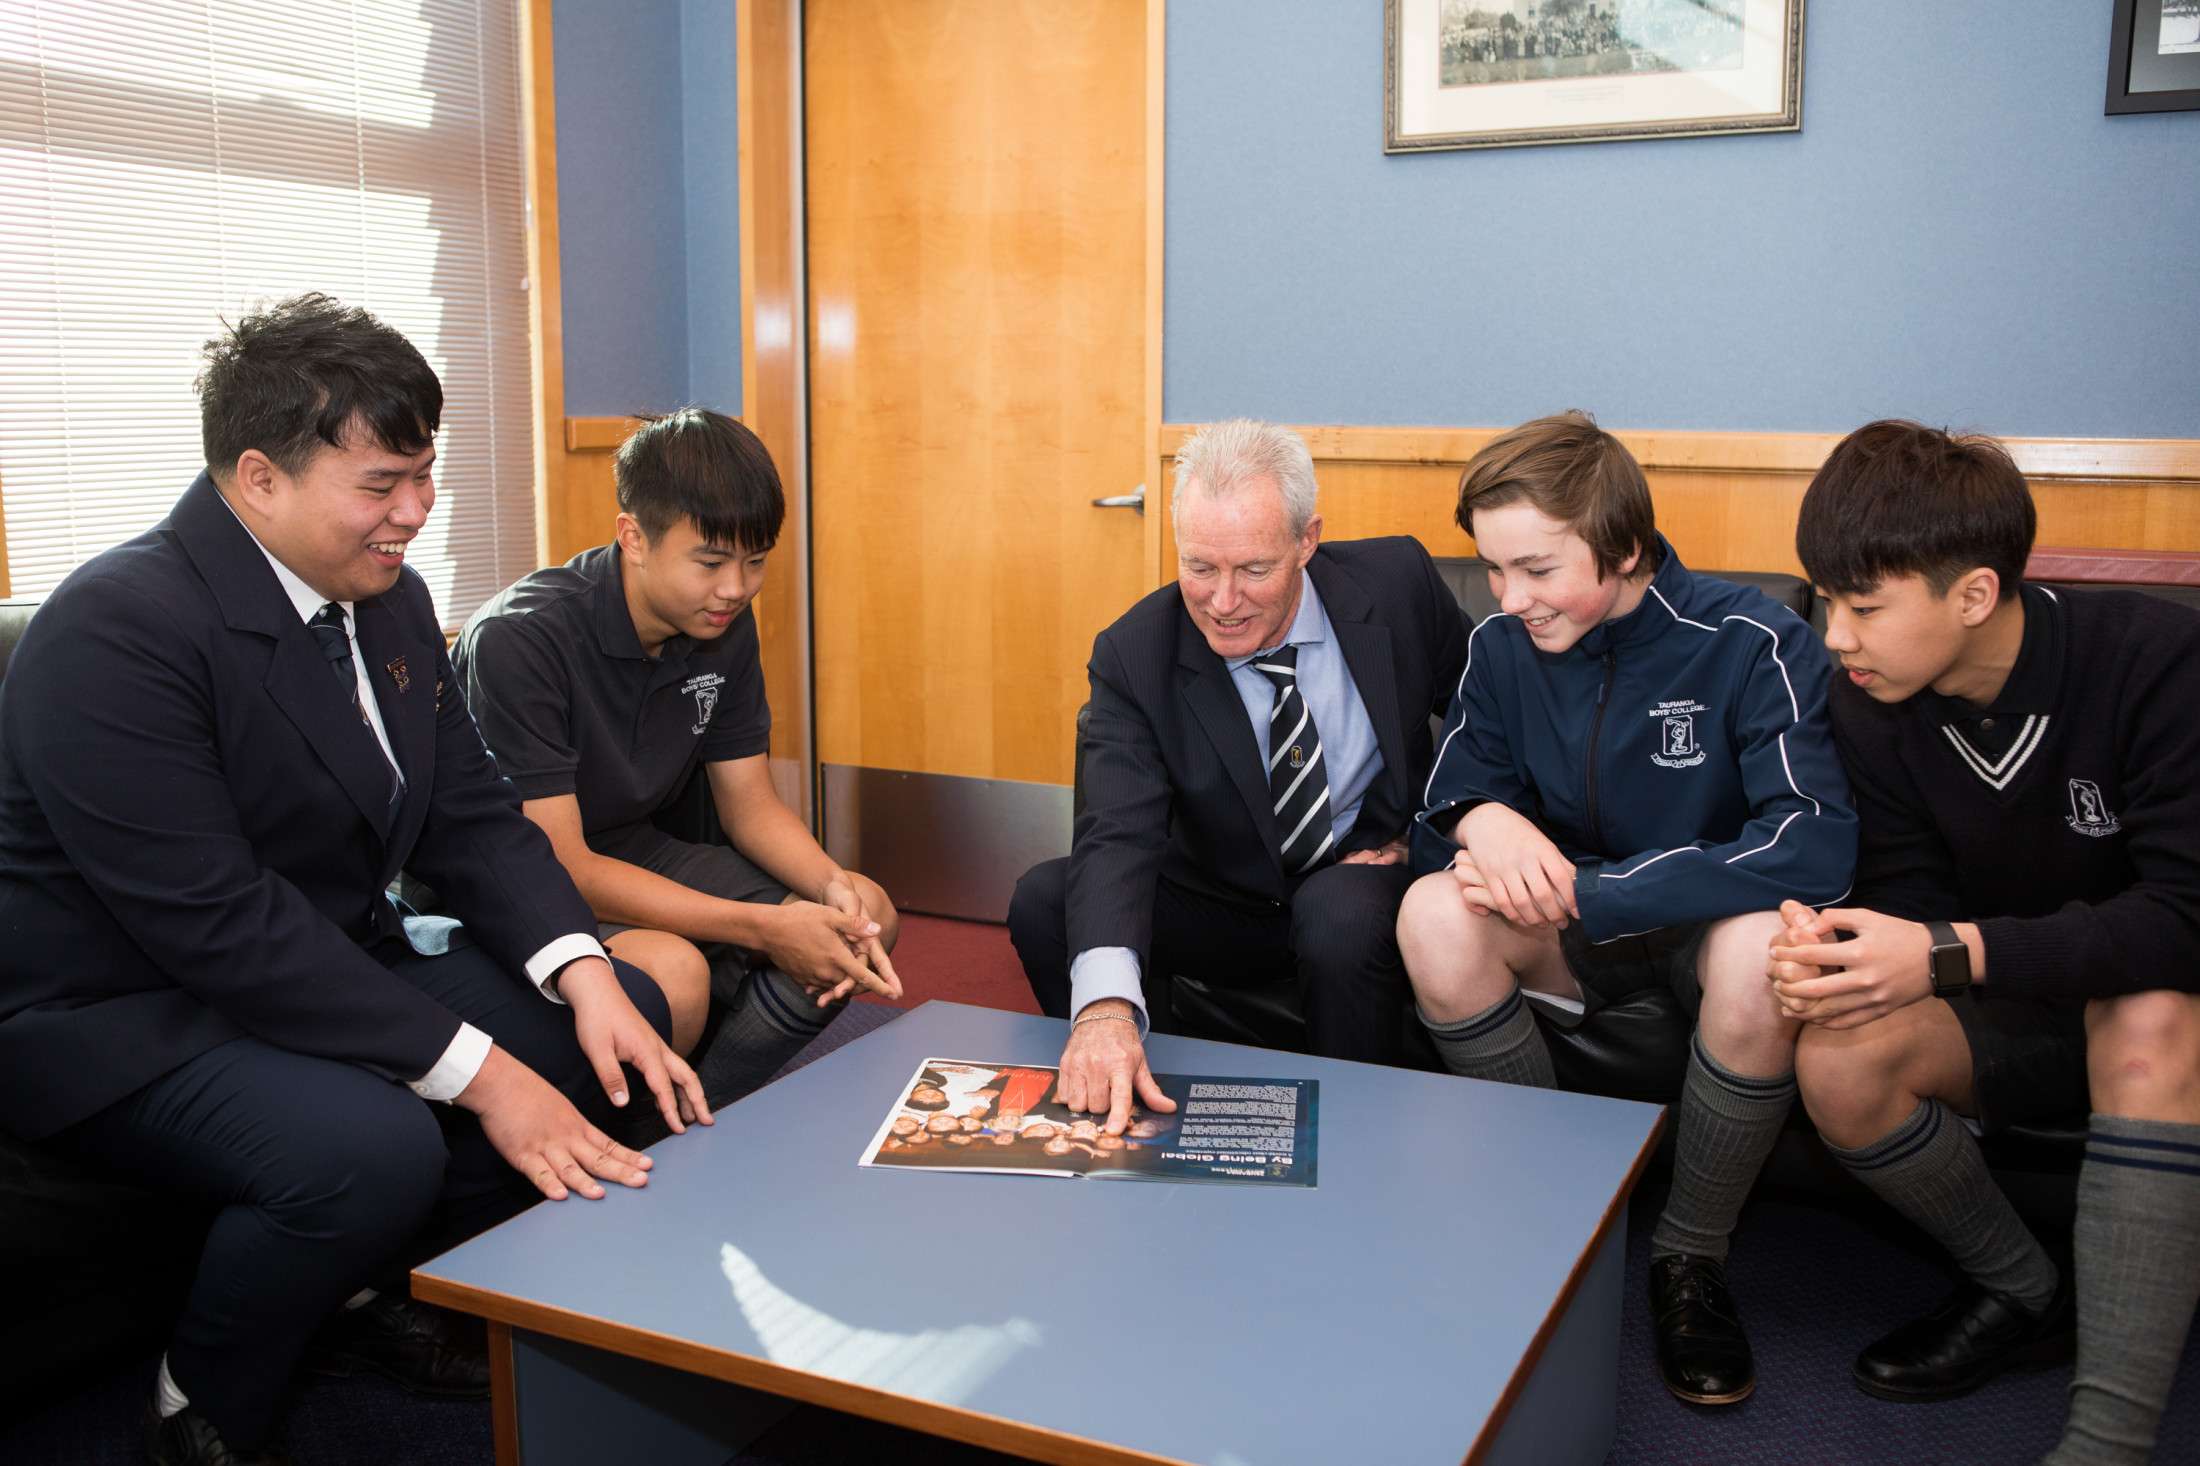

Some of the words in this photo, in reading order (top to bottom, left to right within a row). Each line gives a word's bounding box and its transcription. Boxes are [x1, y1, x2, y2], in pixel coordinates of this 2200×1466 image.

[686, 673, 717, 685] TAURANGA
[699, 676, 726, 688] COLLEGE
[1657, 699, 1695, 709] TAURANGA
[1671, 704, 1705, 715] COLLEGE
[1161, 1152, 1214, 1162] Global
[1219, 1154, 1266, 1164] Being
[1271, 1156, 1293, 1165] By
